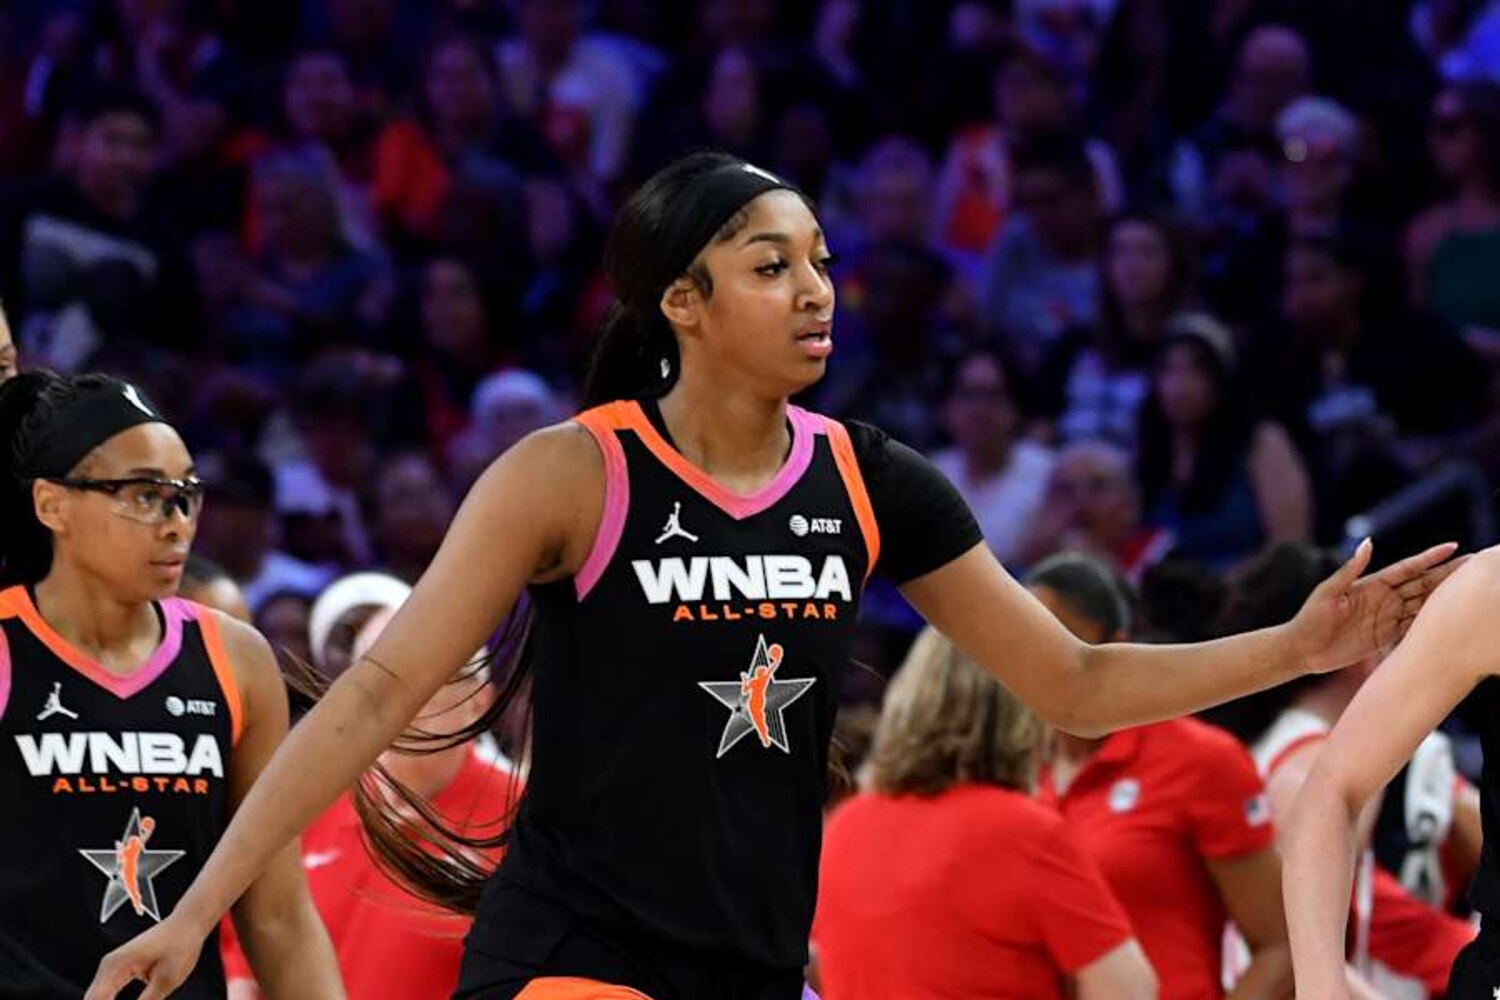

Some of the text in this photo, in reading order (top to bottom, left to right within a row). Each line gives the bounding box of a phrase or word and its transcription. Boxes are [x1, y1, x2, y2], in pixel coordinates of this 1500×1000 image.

[810, 519, 842, 534] AT&T
[631, 554, 852, 604] WNBA
[673, 602, 838, 622] ALL-STAR
[186, 699, 216, 716] AT&T
[14, 731, 225, 778] WNBA
[52, 776, 210, 795] ALL-STAR
